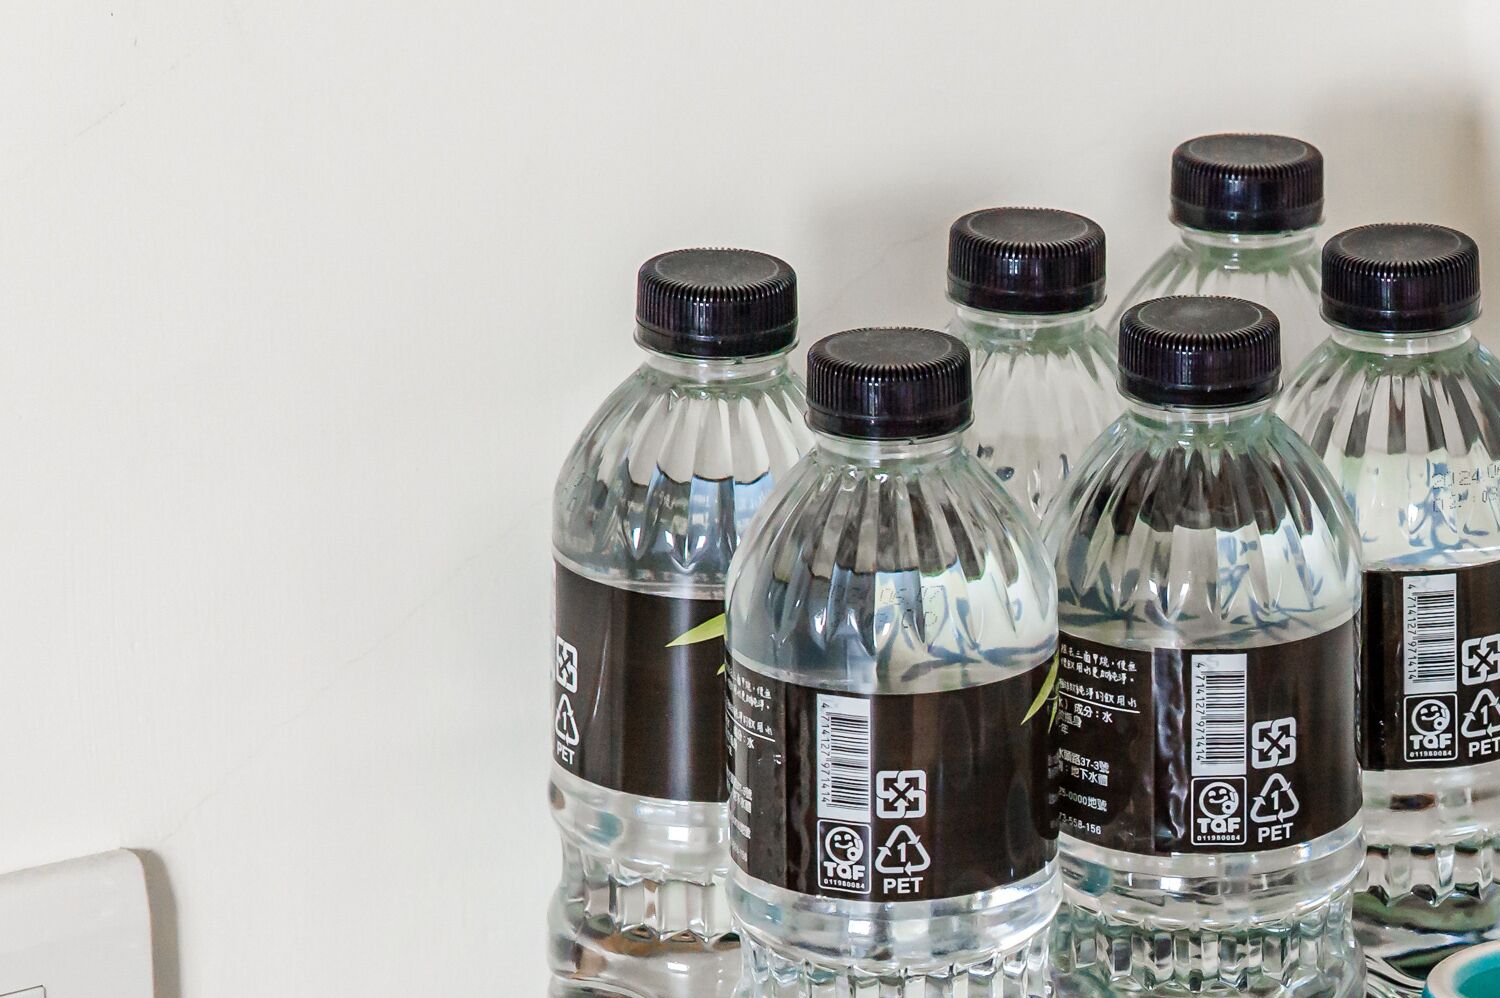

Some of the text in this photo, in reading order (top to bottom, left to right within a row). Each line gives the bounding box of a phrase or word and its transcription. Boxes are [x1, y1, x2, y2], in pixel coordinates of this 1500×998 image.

[1480, 704, 1489, 726] 1
[1409, 733, 1453, 750] TQF
[556, 740, 575, 765] PET
[1270, 789, 1280, 811] 1
[1196, 817, 1241, 834] TQF
[1258, 822, 1294, 843] PET
[897, 841, 907, 863] 1
[823, 861, 866, 880] TQF
[883, 876, 924, 894] PET
